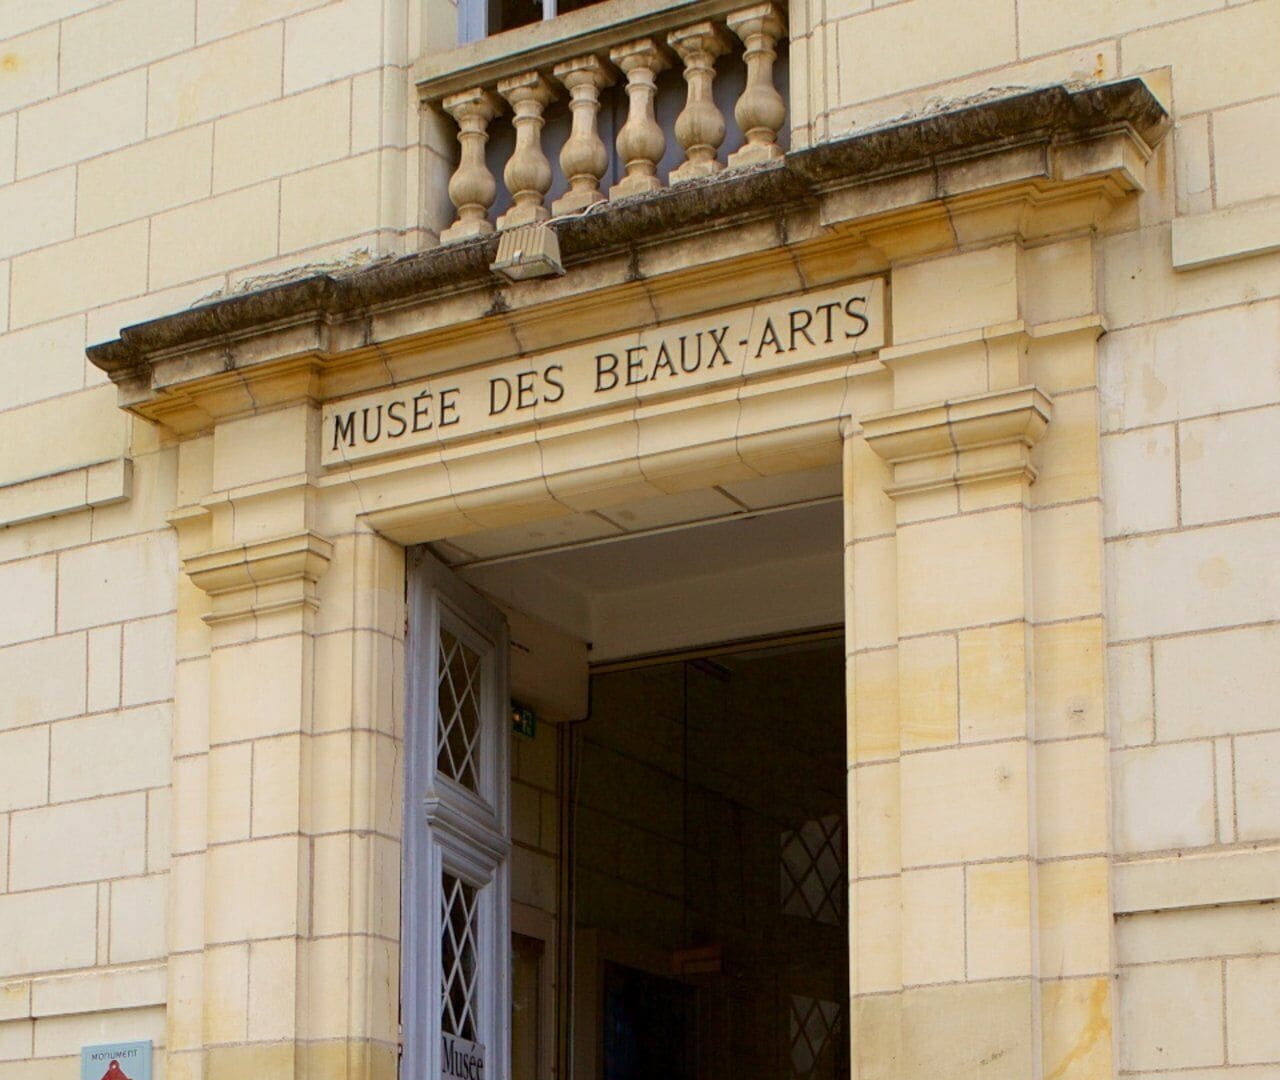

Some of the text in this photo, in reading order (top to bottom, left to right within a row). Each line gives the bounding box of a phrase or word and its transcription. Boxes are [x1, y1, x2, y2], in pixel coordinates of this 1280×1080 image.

[331, 295, 870, 451] MUSÉE DES BEAUX-ARTS
